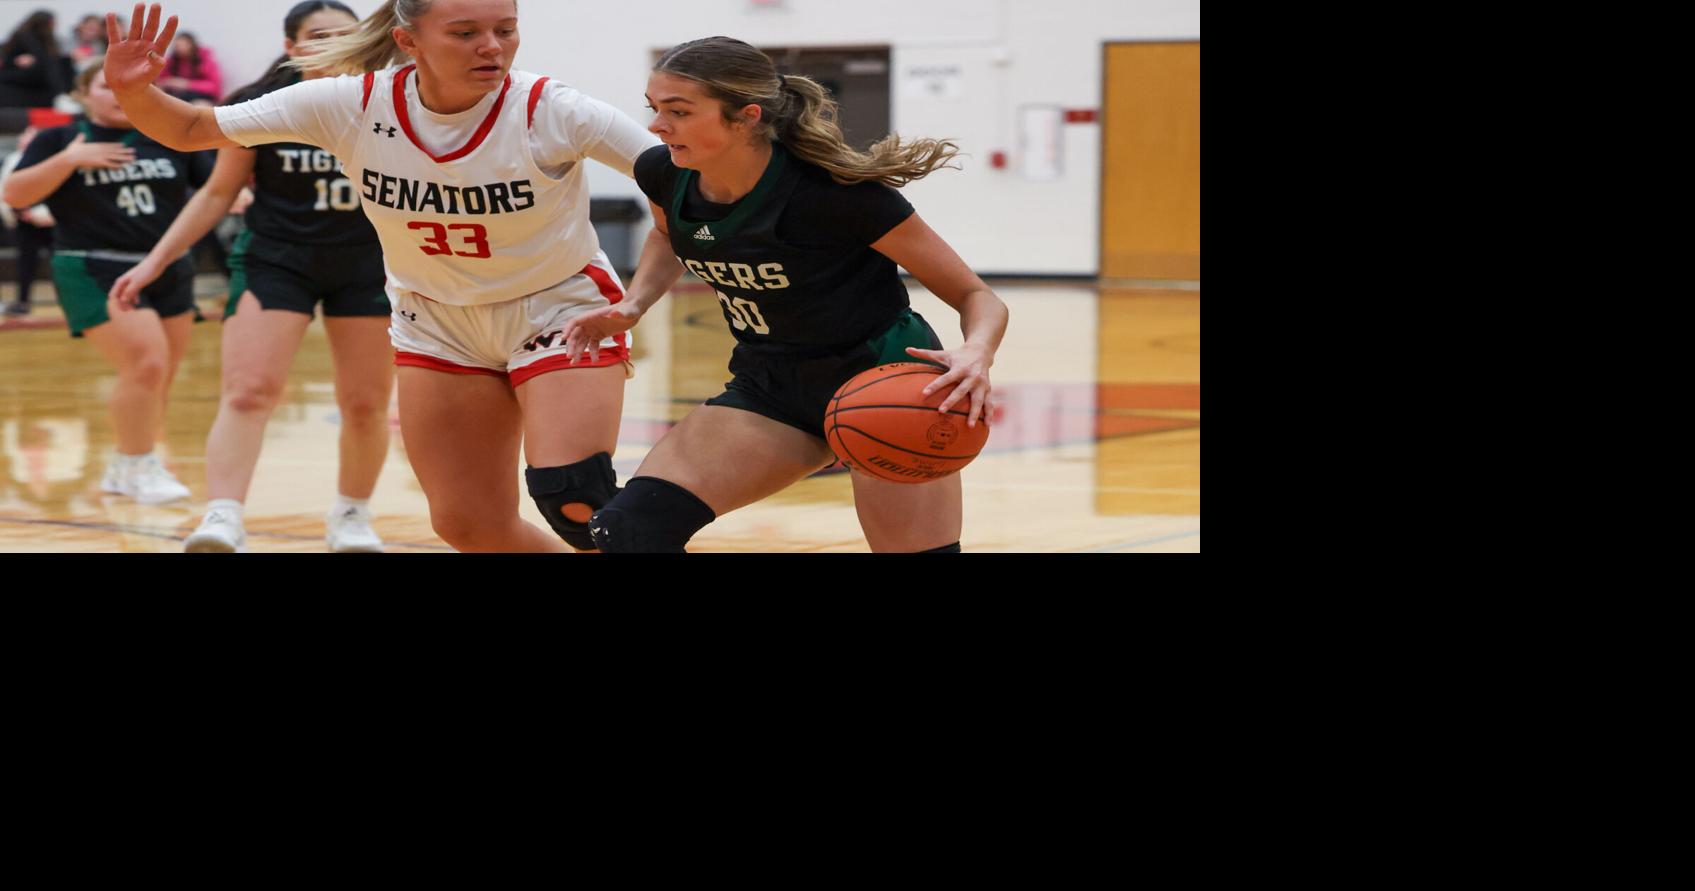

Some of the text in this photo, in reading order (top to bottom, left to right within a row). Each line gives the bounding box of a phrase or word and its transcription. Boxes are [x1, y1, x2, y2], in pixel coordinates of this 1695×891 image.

[116, 186, 156, 217] 40
[313, 178, 361, 211] 10
[362, 168, 535, 215] SENATORS
[407, 221, 492, 259] 33
[693, 233, 715, 241] adidas
[676, 255, 791, 290] GERS
[716, 290, 770, 335] 30
